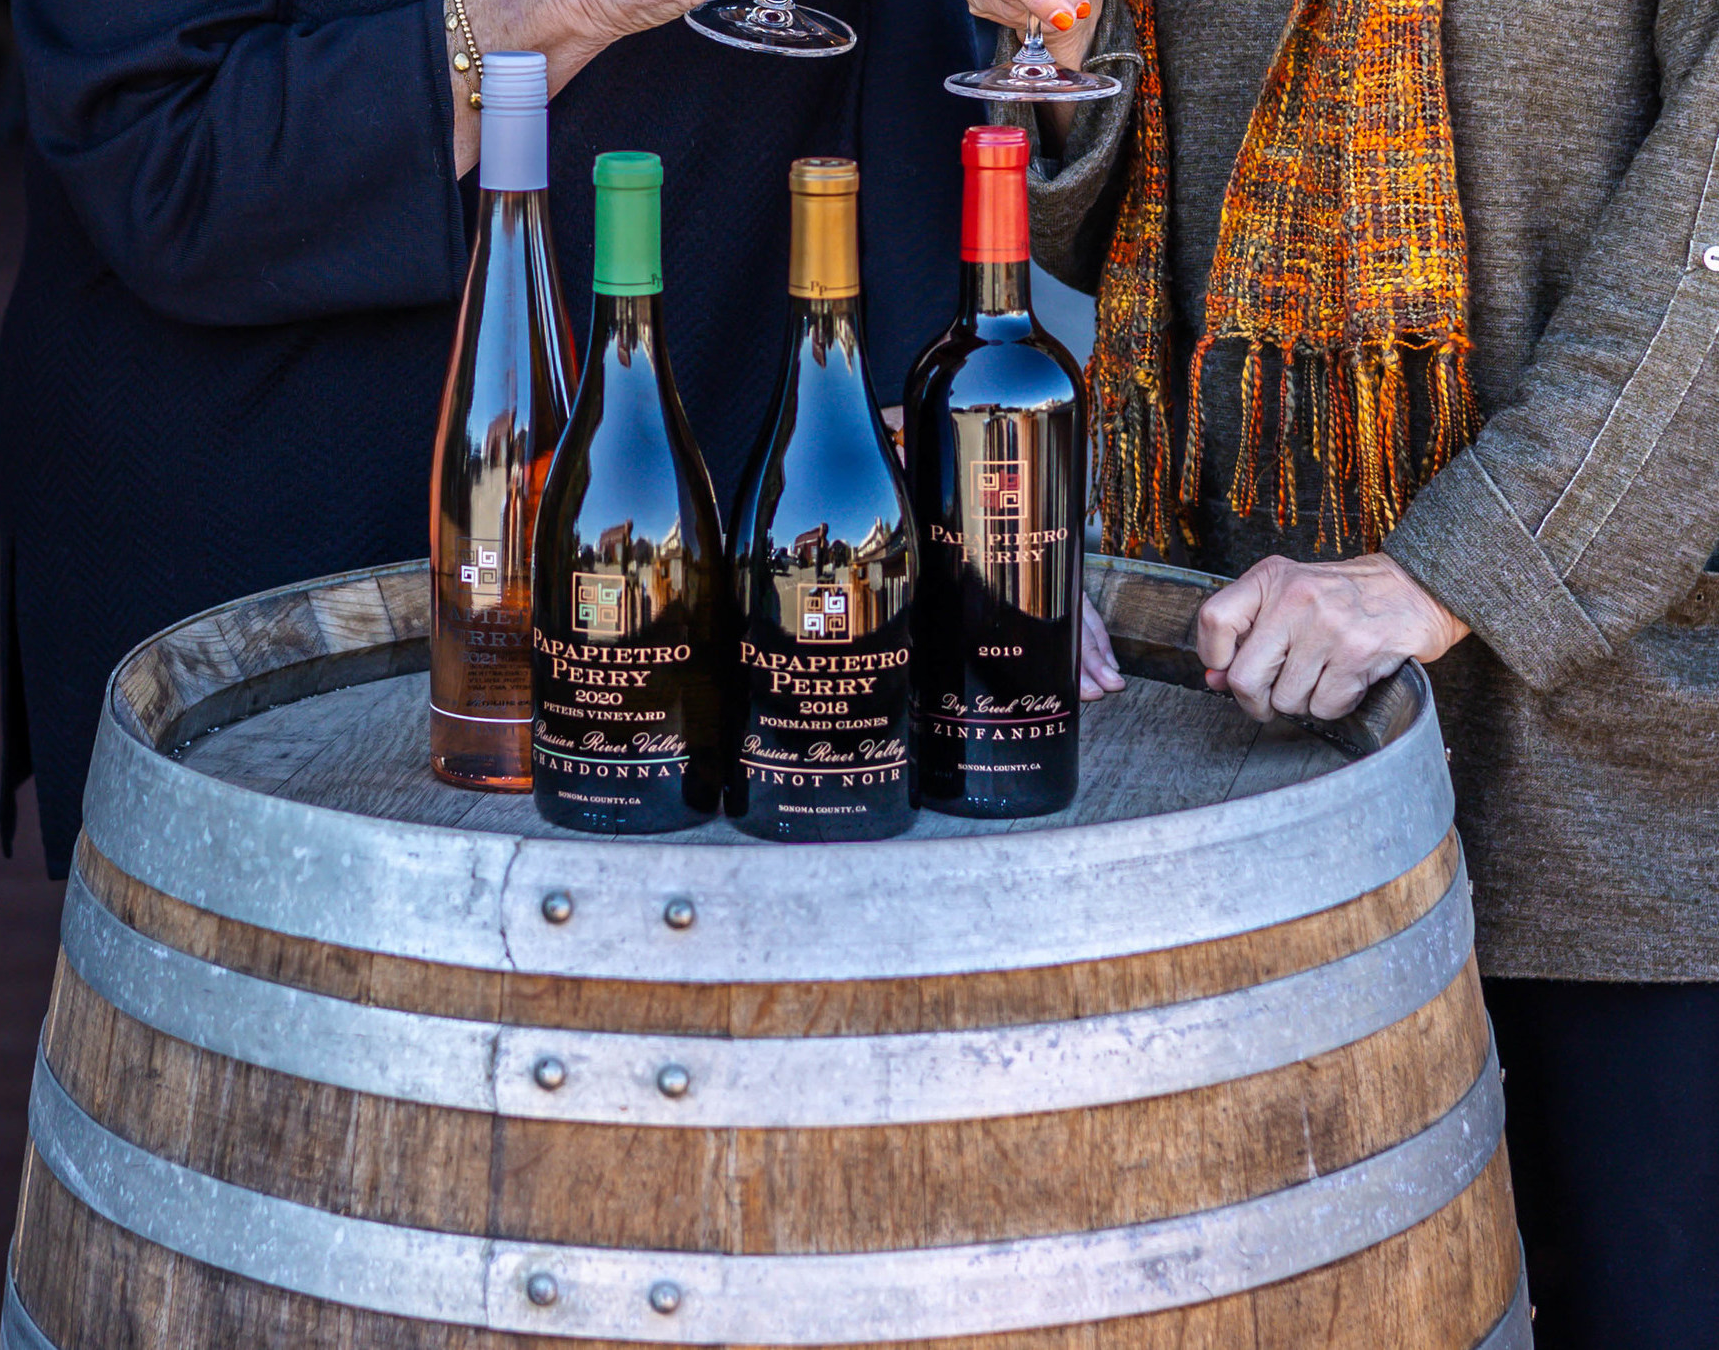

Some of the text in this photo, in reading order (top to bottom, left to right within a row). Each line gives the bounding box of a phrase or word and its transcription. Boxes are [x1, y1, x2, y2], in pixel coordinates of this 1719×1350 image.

[931, 524, 1068, 546] PAPAPIETRO
[961, 546, 1044, 564] PERRY
[533, 627, 691, 664] PAPAPIETRO
[978, 646, 1023, 657] 2019
[740, 641, 909, 673] PAPAPIETRO
[551, 657, 652, 687] PERRY
[770, 671, 878, 696] PERRY
[575, 689, 623, 705] 2020
[941, 693, 968, 716] Dry
[973, 695, 1019, 714] Creek
[1021, 695, 1062, 714] Valley
[543, 701, 585, 718] PETERS
[586, 709, 666, 722] VINEYARD
[799, 701, 849, 715] 2018
[759, 715, 889, 730] POMMARD CLONES
[933, 721, 1066, 740] ZINFANDEL
[535, 719, 575, 748] Russian
[579, 731, 628, 754] River
[632, 732, 687, 756] Valley
[741, 734, 906, 763] Russian River Valley
[532, 749, 689, 778] CHARDONNAY
[957, 763, 992, 772] SONOMA
[746, 767, 900, 787] PINOT NOIR
[558, 790, 641, 805] SONOMA COUNTY, CA
[778, 804, 814, 814] SONOMA
